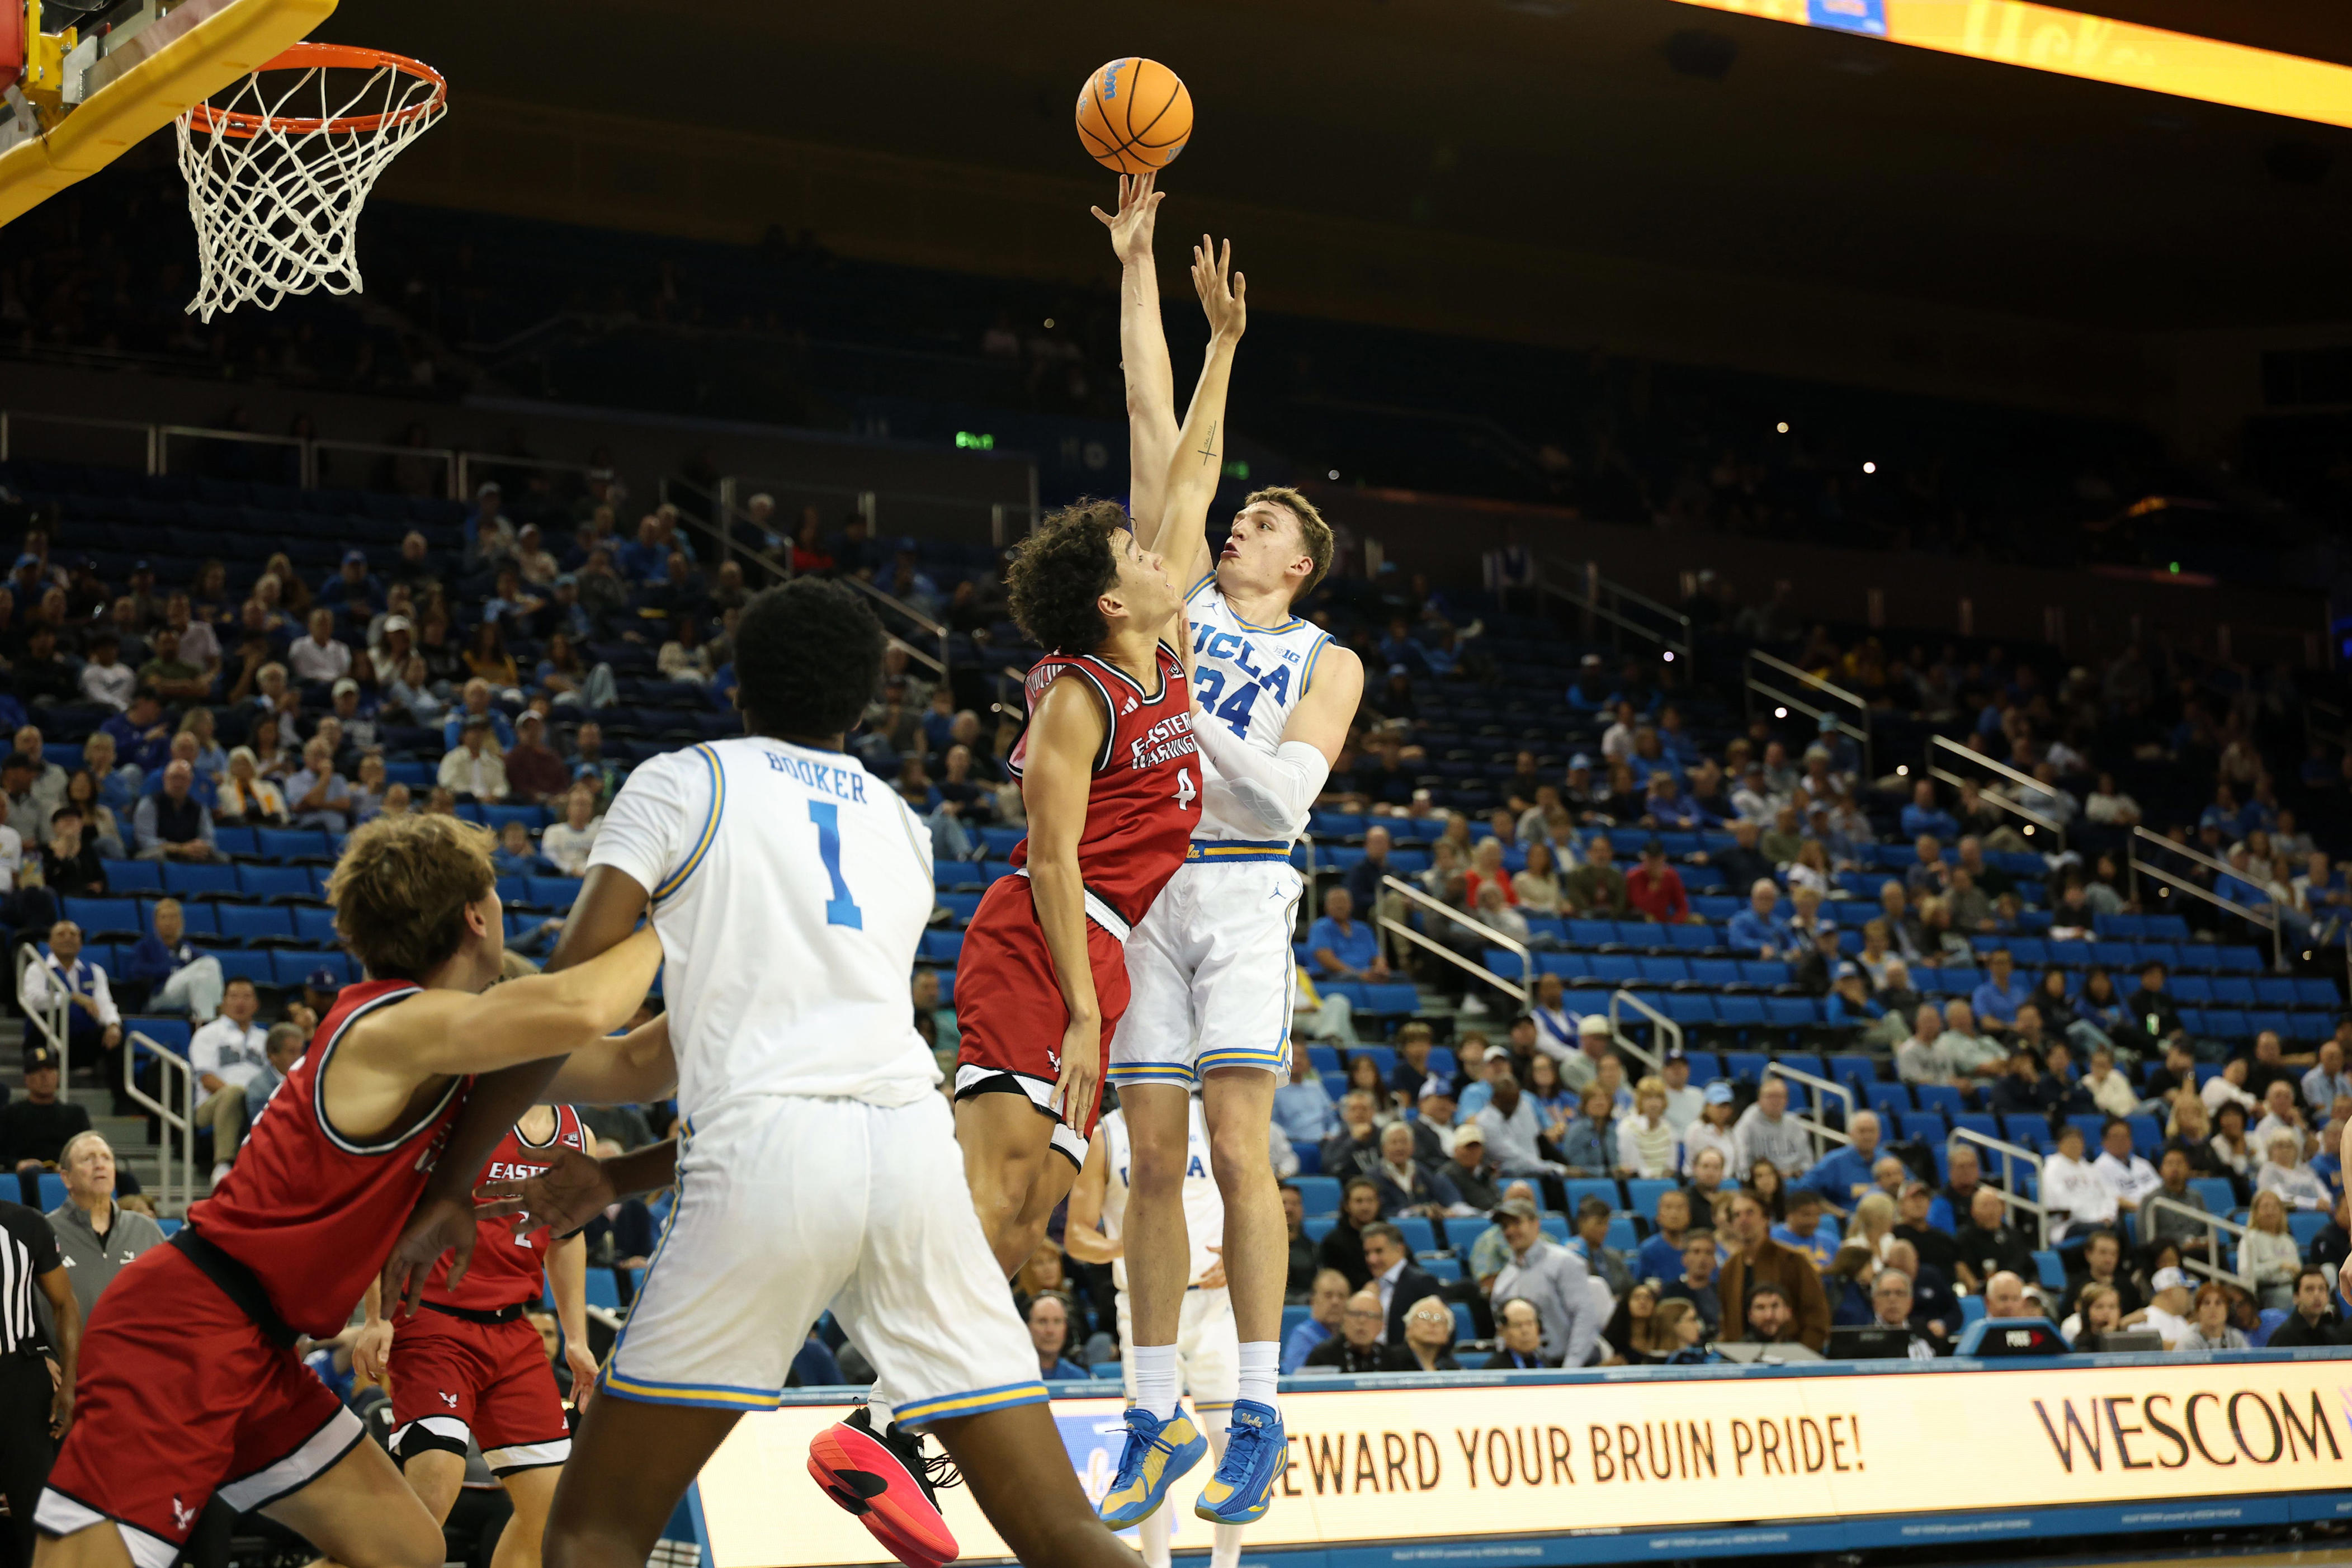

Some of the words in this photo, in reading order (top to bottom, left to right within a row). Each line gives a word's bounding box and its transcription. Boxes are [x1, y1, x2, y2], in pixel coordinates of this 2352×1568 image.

[1189, 622, 1291, 708] UCLA
[1193, 665, 1261, 741] 34
[1131, 711, 1192, 758] EASTER
[1132, 733, 1198, 770] WASHINGT
[764, 750, 868, 805] BOOKER
[1170, 767, 1197, 811] 4
[807, 799, 863, 932] 1
[1271, 1431, 1441, 1498] EWARD
[1456, 1425, 1576, 1488] YOUR
[1589, 1420, 1717, 1483] BRUIN
[1731, 1414, 1865, 1476] PRIDE!
[2031, 1388, 2344, 1473] WESCOM
